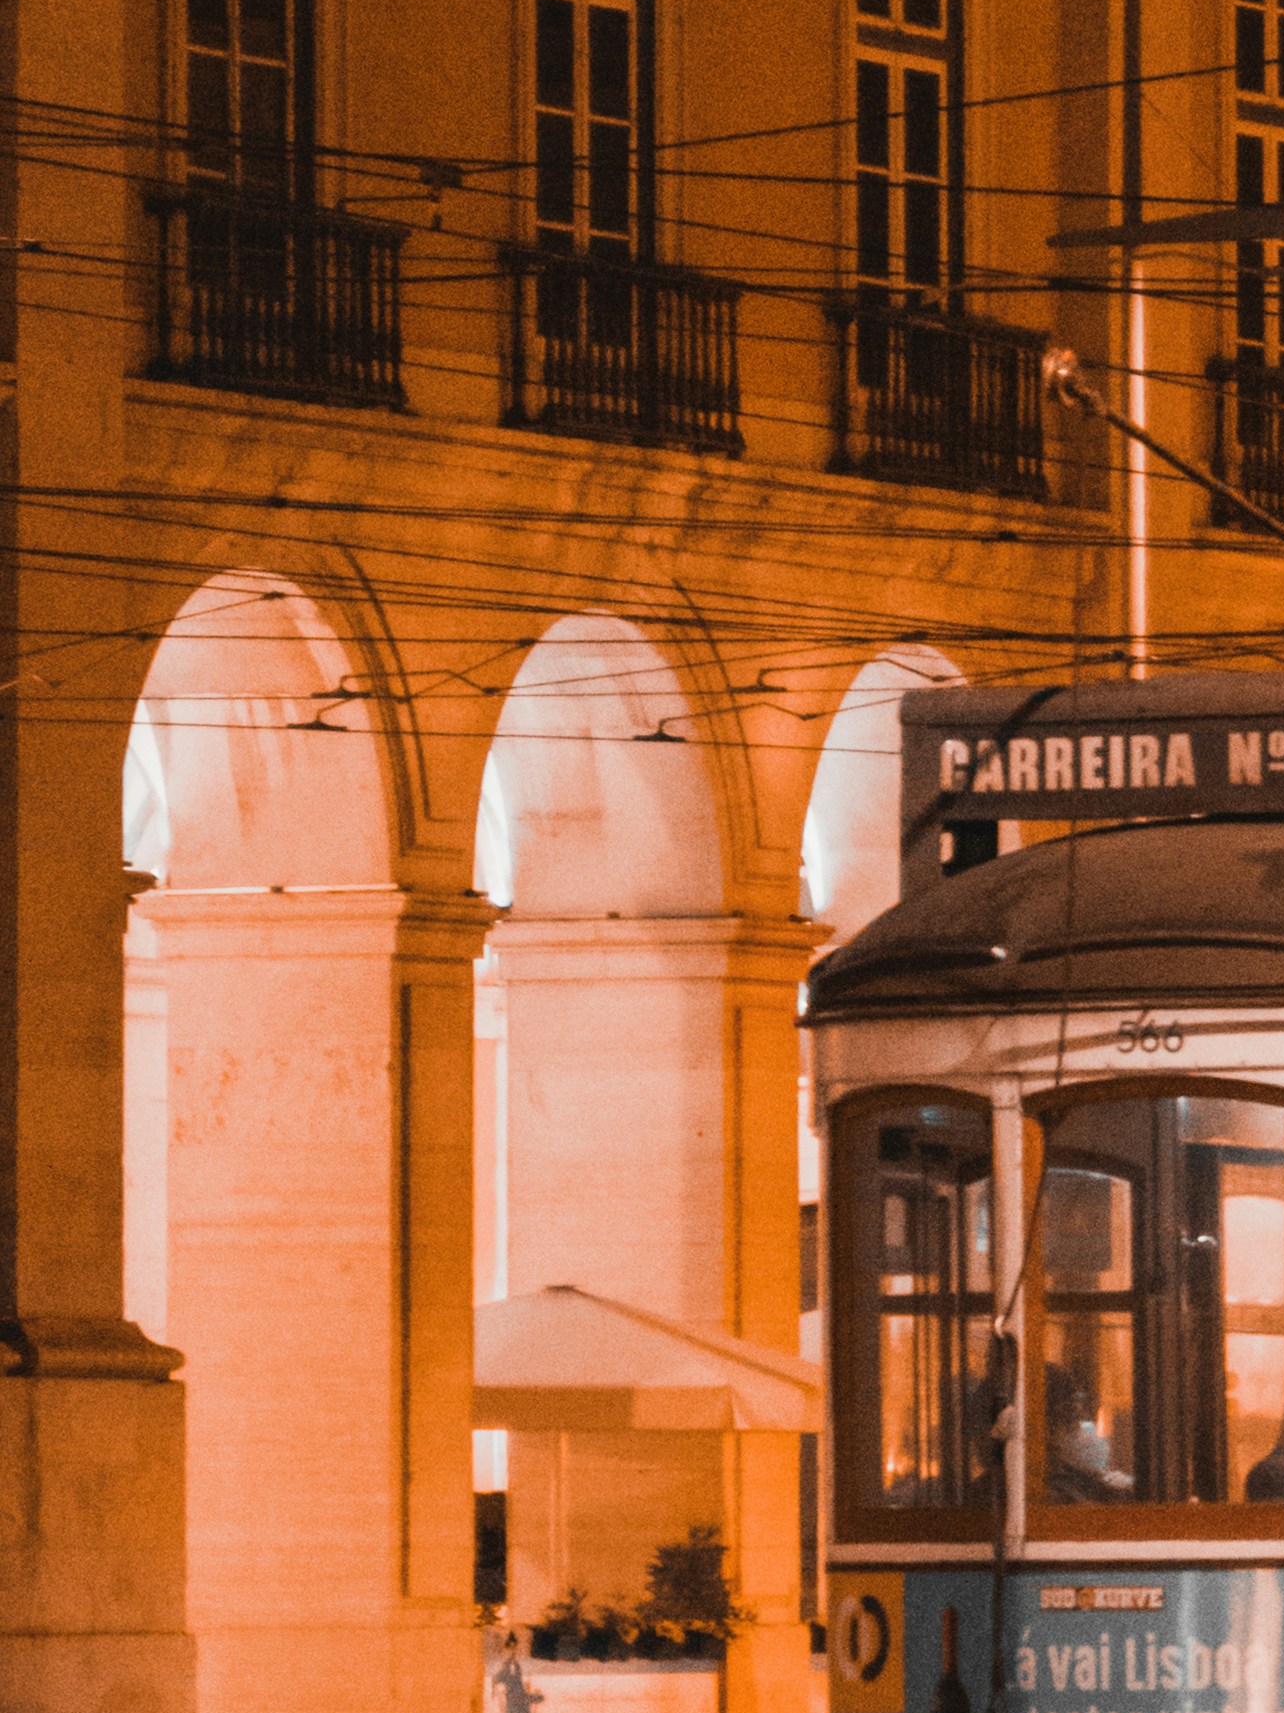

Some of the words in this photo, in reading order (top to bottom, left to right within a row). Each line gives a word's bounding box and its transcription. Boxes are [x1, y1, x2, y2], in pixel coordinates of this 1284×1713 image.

[939, 732, 1197, 793] CARREIRA
[1117, 1018, 1184, 1054] 566
[1046, 1632, 1111, 1690] vai
